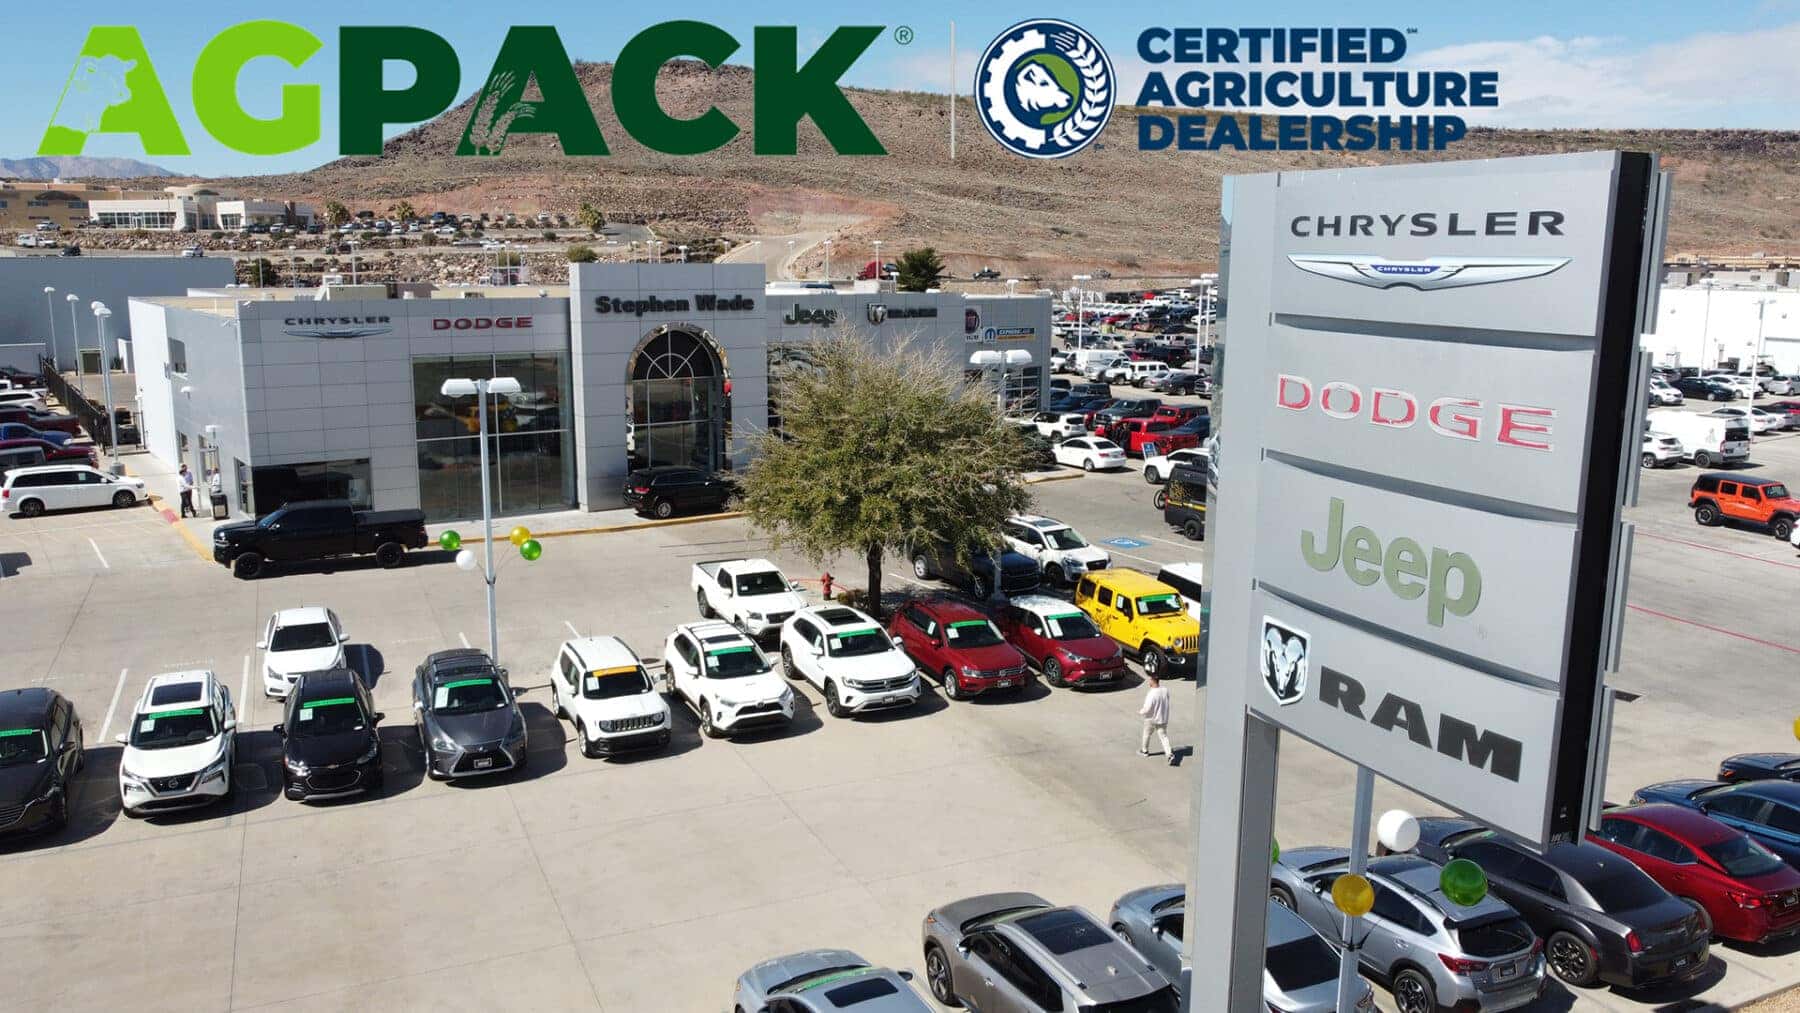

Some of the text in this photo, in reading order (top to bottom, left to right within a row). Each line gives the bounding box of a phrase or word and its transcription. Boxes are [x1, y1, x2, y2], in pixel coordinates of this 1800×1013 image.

[1290, 210, 1566, 238] CHRYSLER
[595, 294, 755, 318] Stephen Wade
[284, 315, 391, 326] CHRYSLER
[432, 316, 534, 331] DODGE
[1276, 373, 1558, 453] DODGE
[1300, 497, 1482, 628] Jeep
[1318, 665, 1524, 783] RAM
